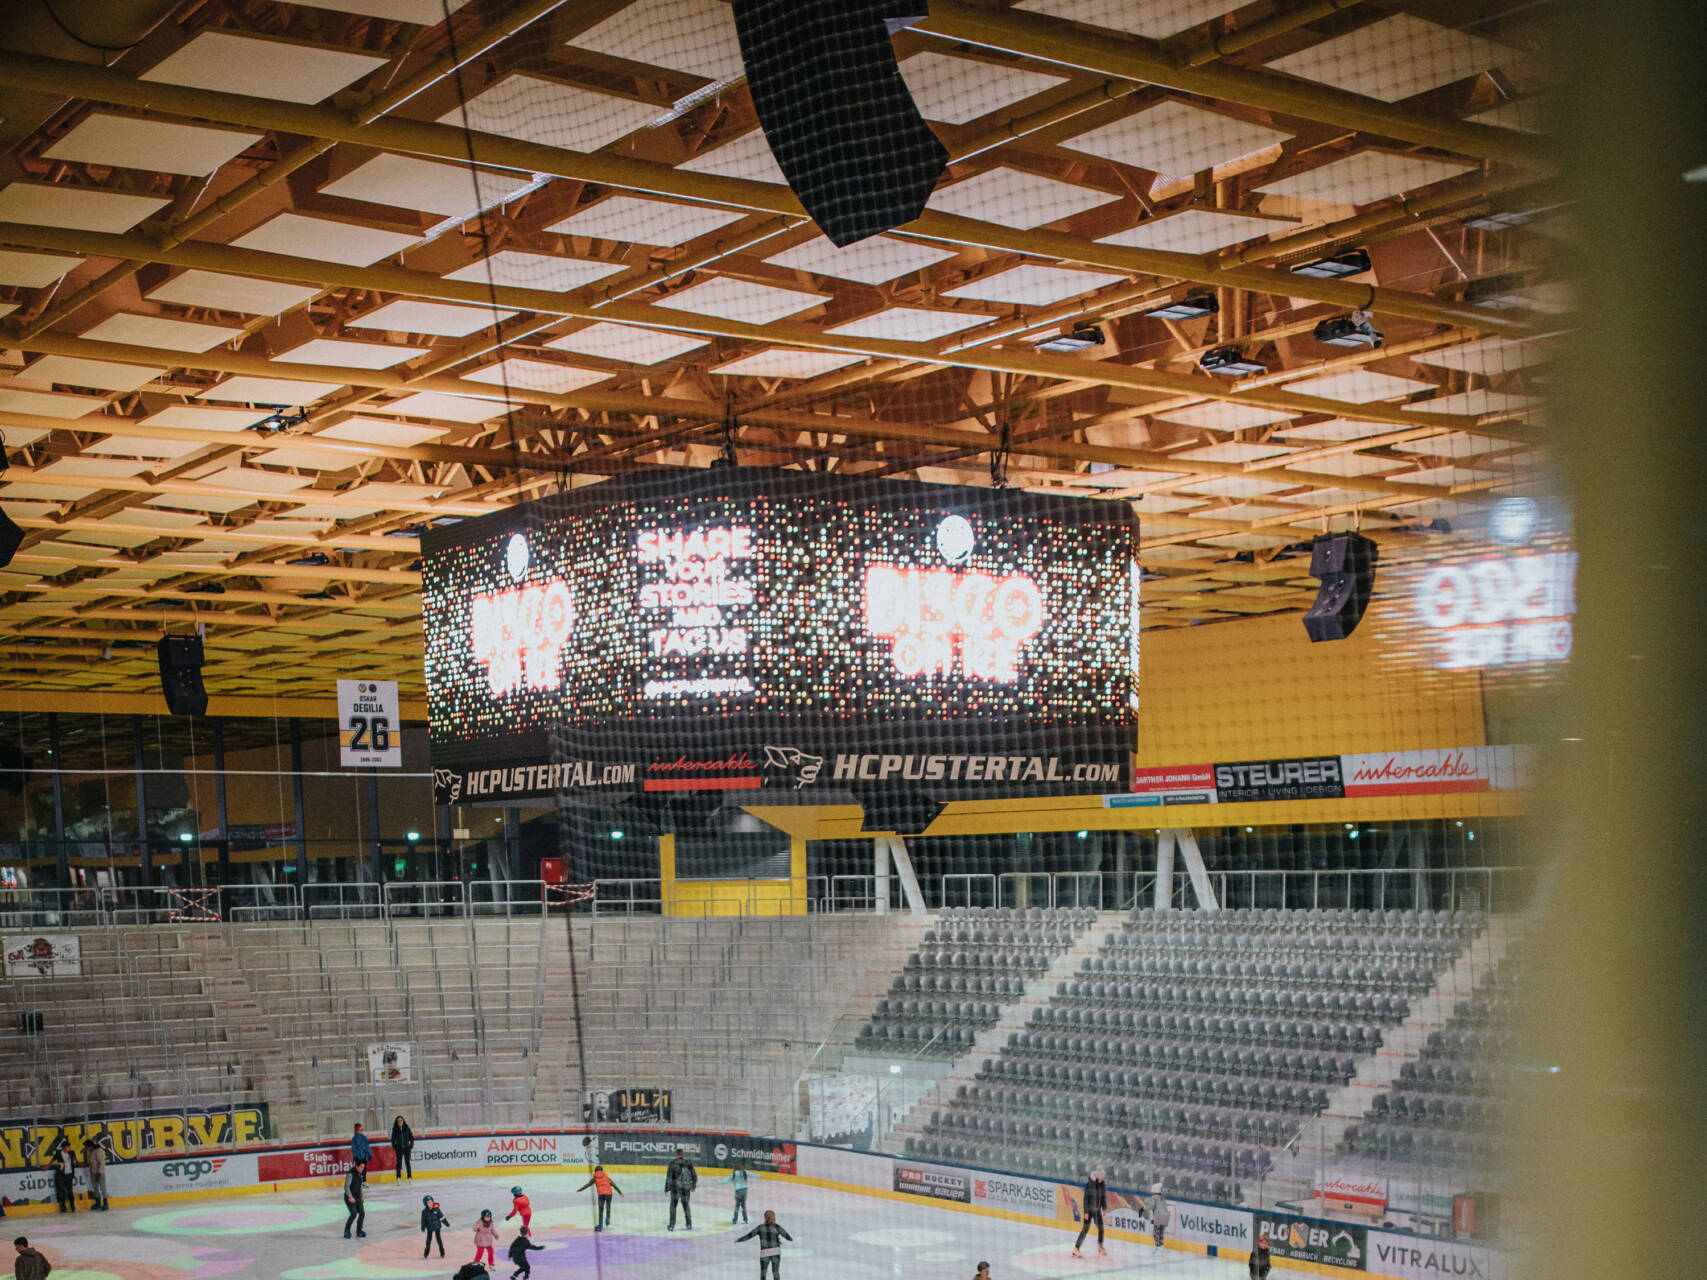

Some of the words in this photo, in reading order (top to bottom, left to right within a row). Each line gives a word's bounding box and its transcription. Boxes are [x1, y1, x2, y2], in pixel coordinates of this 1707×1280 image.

[637, 529, 751, 562] SHARE
[665, 557, 726, 581] YOUR
[640, 572, 752, 617] STORIES
[673, 606, 721, 627] AND
[648, 628, 707, 657] TAG
[709, 627, 747, 654] US
[353, 703, 384, 713] DEGILIA
[349, 714, 391, 753] 26
[647, 751, 758, 773] intercable
[834, 754, 1120, 782] HCPUSTERTAL.COM
[1353, 752, 1479, 784] intercable
[466, 760, 635, 796] HCPUSTERTAL.COM
[1216, 760, 1340, 787] STEURER
[1268, 787, 1298, 796] LIVING
[1306, 784, 1343, 794] DESIGN
[424, 1149, 477, 1161] betonform
[487, 1137, 557, 1152] AMONN
[604, 1141, 676, 1153] PLAICKNER
[731, 1148, 790, 1162] Schmidhammer
[304, 1151, 315, 1162] Es
[315, 1153, 333, 1163] lebe
[487, 1154, 518, 1165] PROFI
[522, 1153, 557, 1164] COLOR
[162, 1160, 212, 1182] engo
[924, 1174, 963, 1186] HOCKEY
[988, 1179, 1054, 1203] SPARKASSE
[1115, 1216, 1146, 1232] BETON
[1180, 1213, 1248, 1239] Volksbank
[1324, 1255, 1358, 1267] RECYCLING
[1377, 1243, 1485, 1278] VITRALUX
